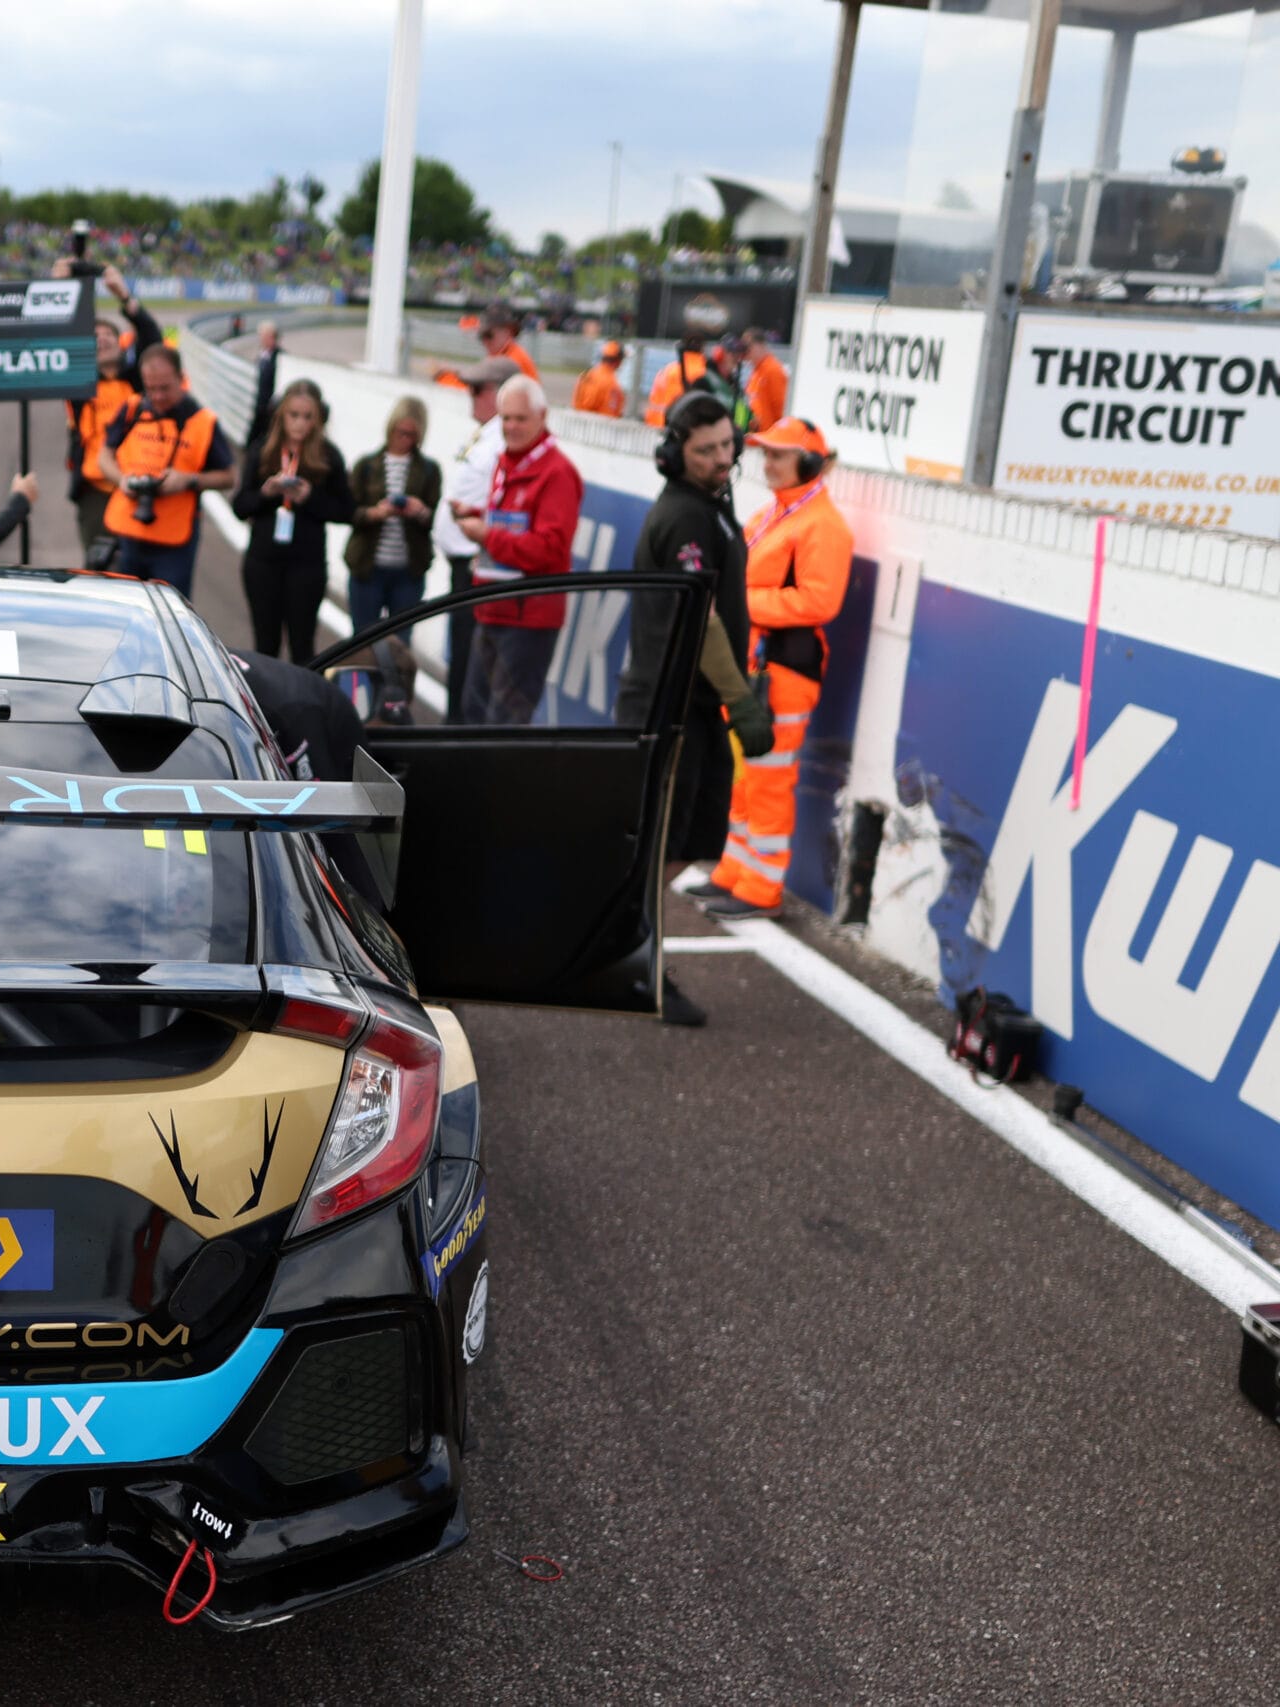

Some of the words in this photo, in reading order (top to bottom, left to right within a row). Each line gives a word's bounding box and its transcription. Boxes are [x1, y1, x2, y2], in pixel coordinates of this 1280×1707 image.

[826, 328, 946, 383] THRUXTON
[1031, 346, 1280, 397] THRUXTON
[833, 385, 917, 439] CIRCUIT
[1060, 400, 1247, 447] CIRCUIT
[433, 1194, 487, 1278] GOODYEAR
[200, 1506, 226, 1534] TOW
